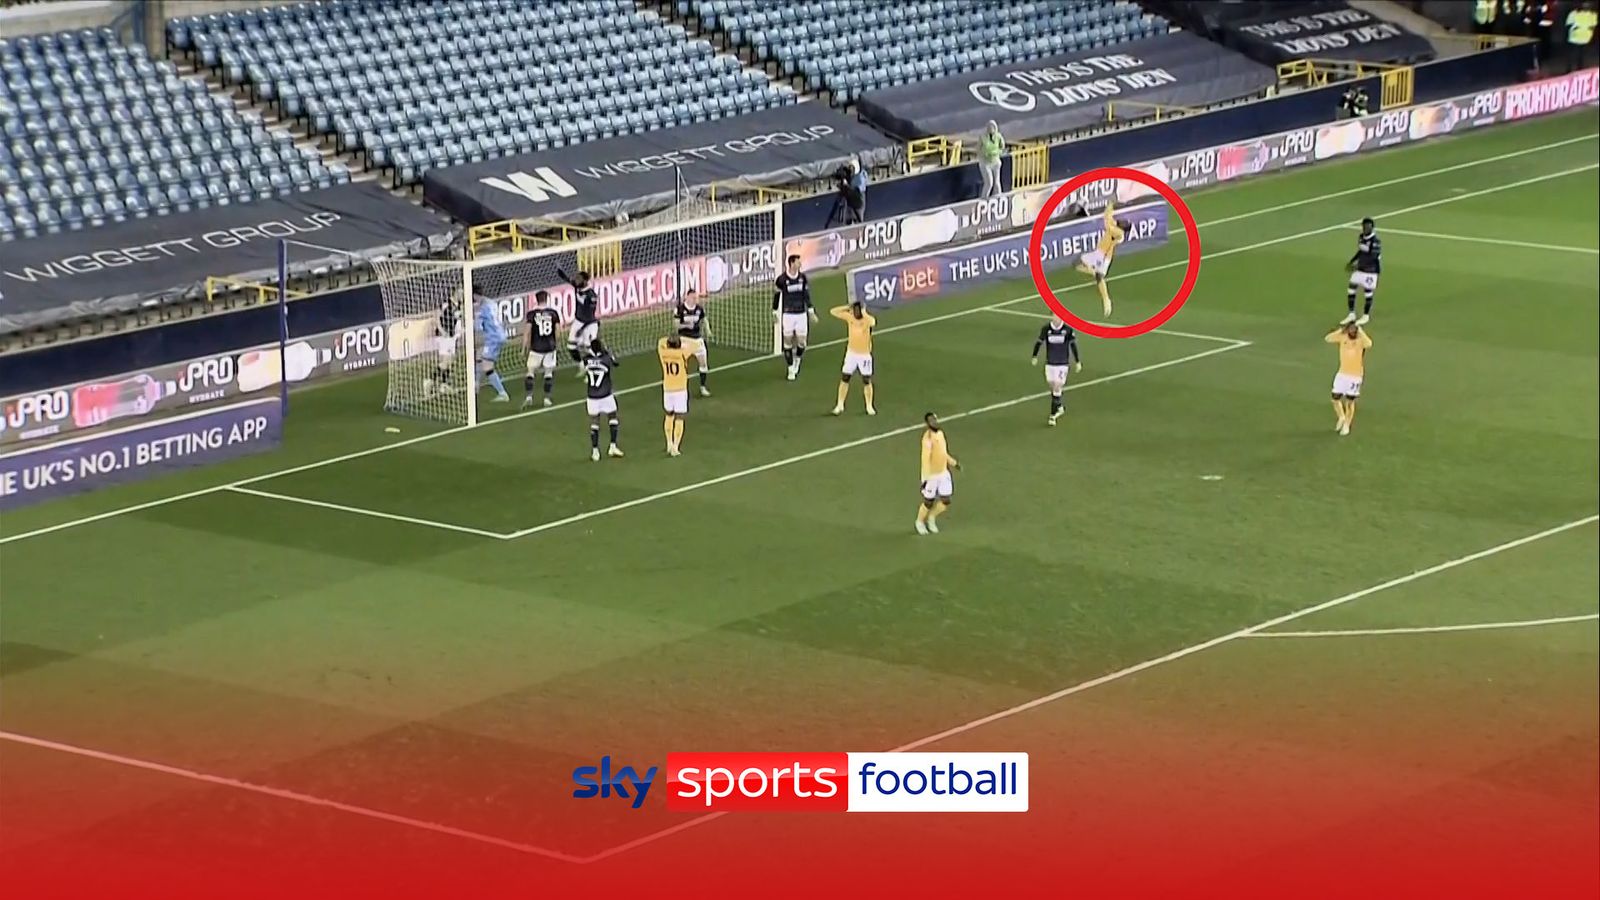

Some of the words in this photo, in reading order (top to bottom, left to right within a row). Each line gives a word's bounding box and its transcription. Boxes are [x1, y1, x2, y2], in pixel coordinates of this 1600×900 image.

[1005, 69, 1071, 87] THIS
[1060, 61, 1095, 77] IS
[1083, 53, 1144, 72] THE
[1115, 68, 1178, 89] DEN
[574, 143, 726, 180] WIGGETT
[723, 124, 836, 154] GROUP
[4, 236, 201, 283] WIGGETT
[201, 210, 342, 249] GROUP
[863, 273, 898, 303] sky
[903, 266, 937, 292] bet
[950, 257, 980, 282] THE
[983, 248, 1020, 274] UK'S
[1127, 217, 1158, 242] APP
[538, 316, 553, 337] 18
[586, 368, 605, 388] 17
[664, 361, 681, 376] 10
[23, 459, 75, 490] UK'S
[80, 446, 131, 479] NO.1
[136, 427, 223, 464] BETTING
[227, 415, 268, 445] APP
